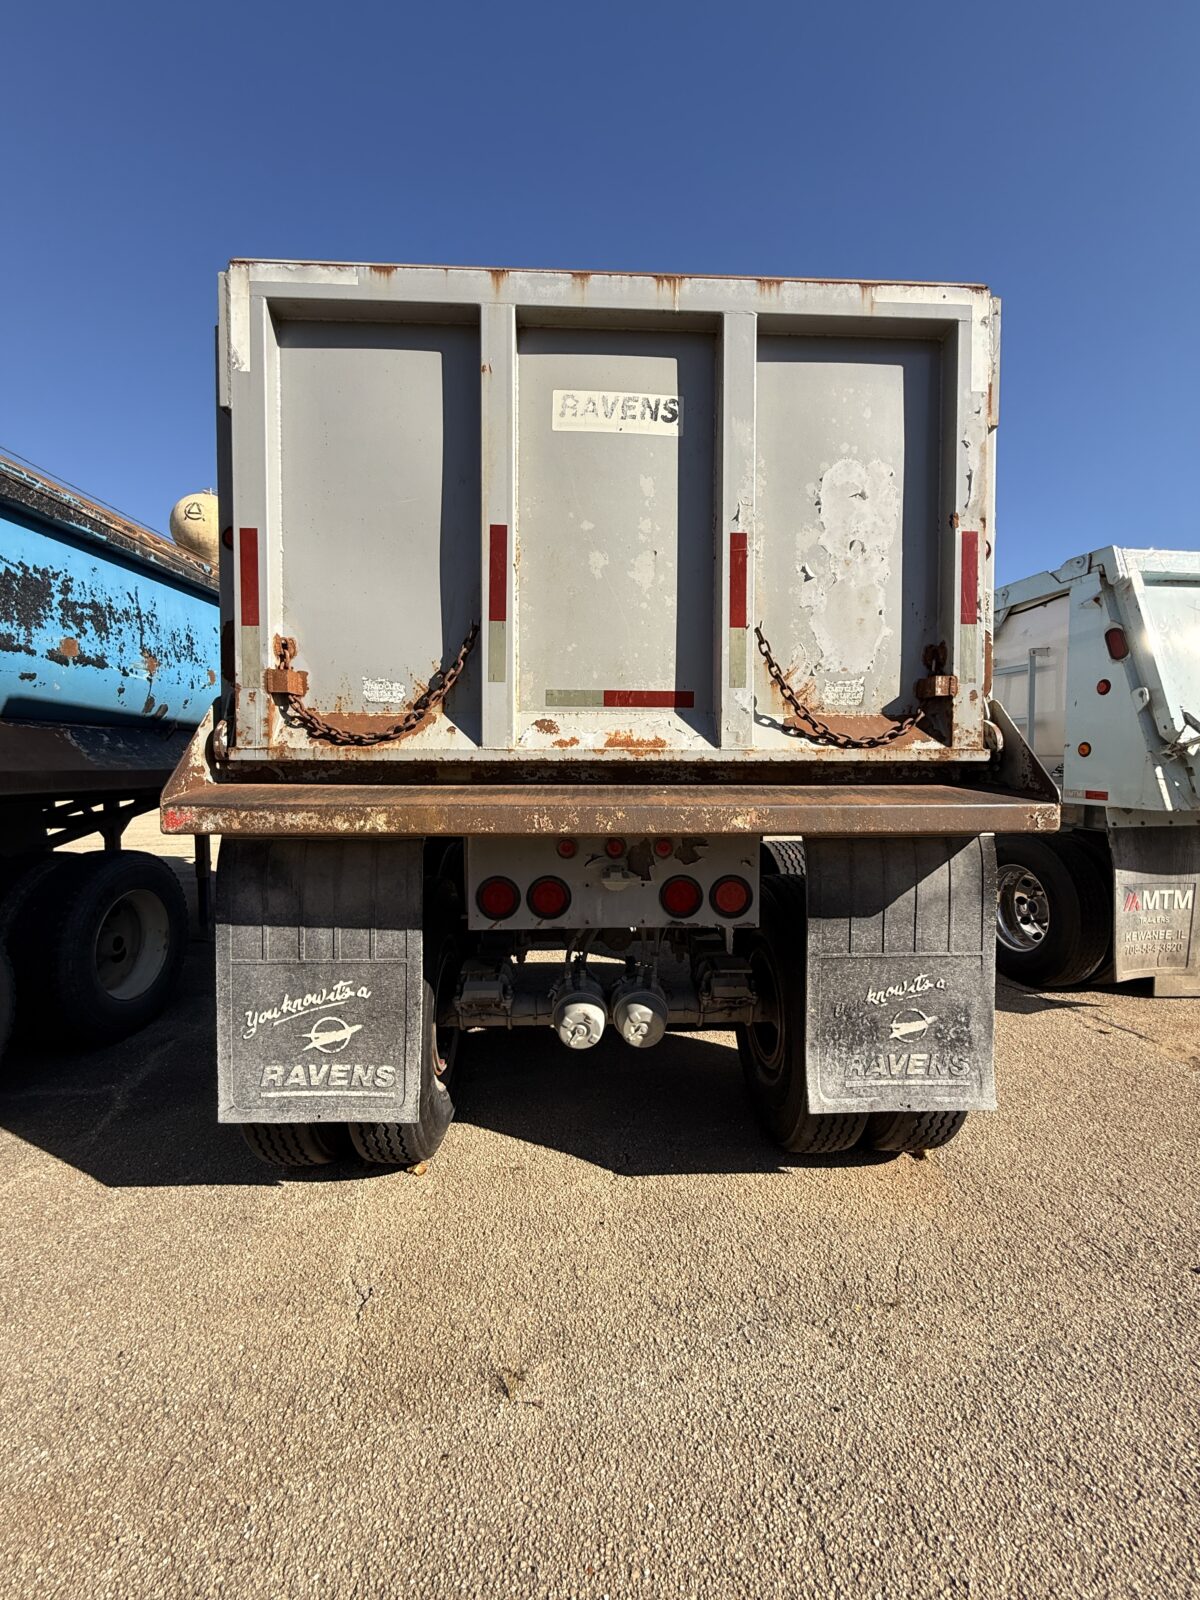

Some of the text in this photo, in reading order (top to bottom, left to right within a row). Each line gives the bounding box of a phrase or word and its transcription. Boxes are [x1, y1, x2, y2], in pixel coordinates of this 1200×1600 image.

[559, 394, 680, 423] RAVENS
[1142, 889, 1194, 911] MTM
[1124, 930, 1187, 943] KEWANEE, IL
[865, 980, 909, 1005] know
[935, 977, 947, 991] a
[243, 1007, 282, 1039] You
[281, 988, 326, 1014] know
[357, 985, 372, 999] a
[260, 1063, 397, 1087] RAVENS
[844, 1053, 971, 1077] RAVENS
